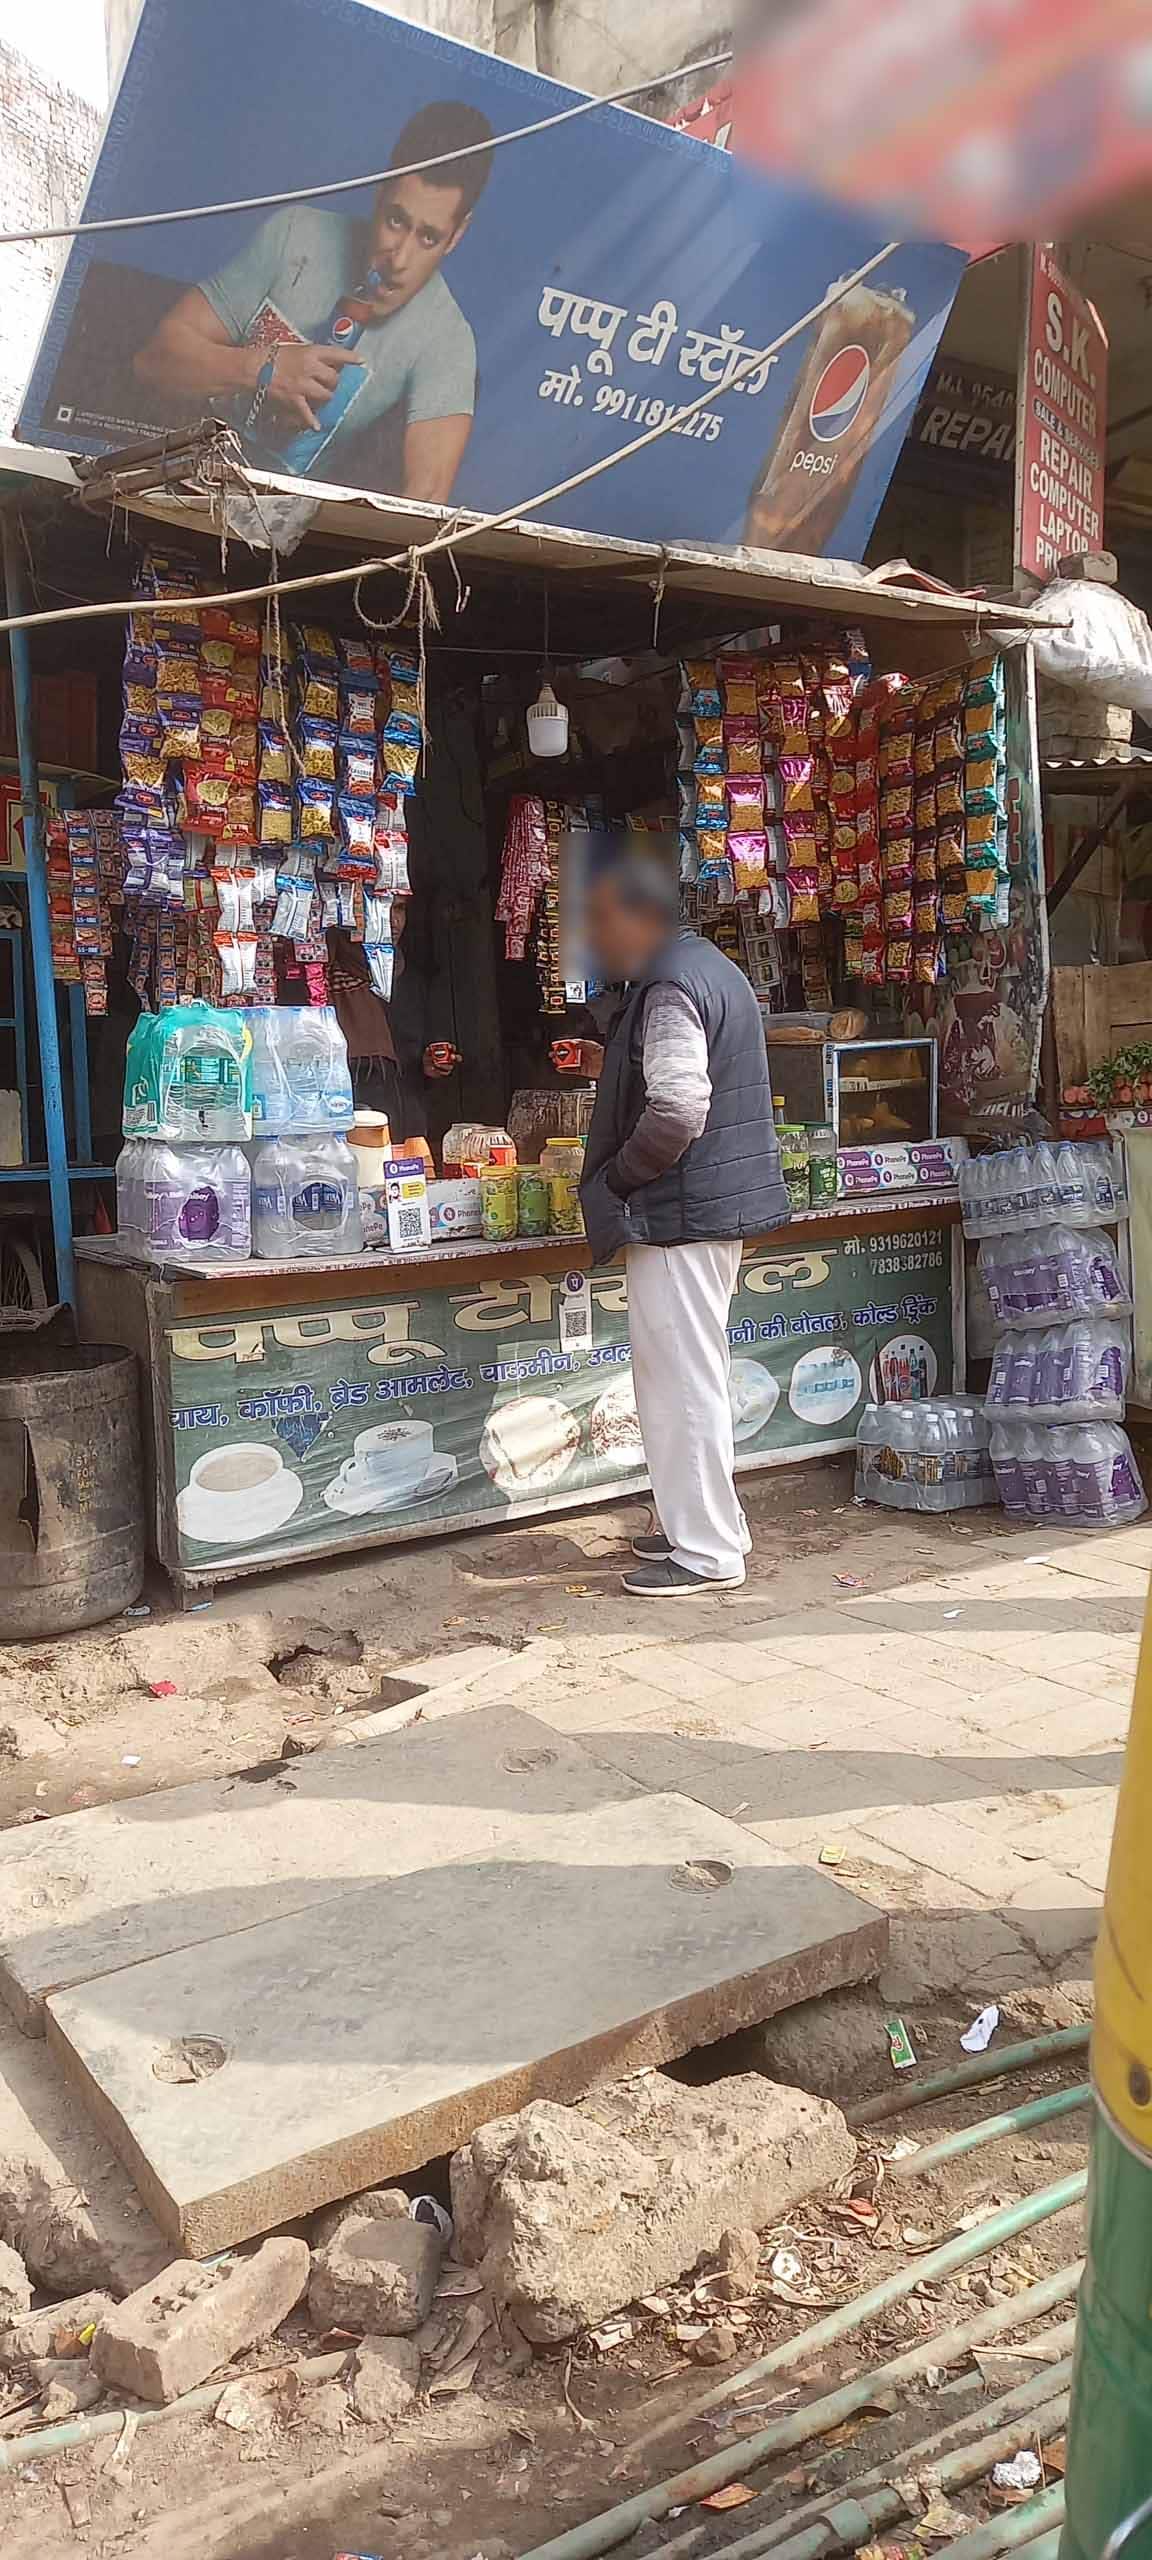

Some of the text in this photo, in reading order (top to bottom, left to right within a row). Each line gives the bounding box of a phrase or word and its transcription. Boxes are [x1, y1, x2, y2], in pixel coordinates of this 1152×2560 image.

[538, 286, 779, 395] पप्पू टी स्टॉल
[538, 364, 584, 407] मो.
[1034, 348, 1097, 438] COMPUTER
[789, 450, 839, 477] pepsi
[1040, 430, 1093, 502] REPAIR
[1030, 462, 1099, 541] COMPUTER
[1039, 503, 1089, 553] LAPTOP
[163, 1300, 448, 1366] पप्पू
[448, 1273, 566, 1332] टी
[843, 1239, 866, 1257] मो.
[869, 1231, 943, 1253] 9319620121
[760, 1313, 787, 1342] की
[851, 1302, 898, 1328] कोल्ड
[900, 1294, 939, 1326] ड्रिंक
